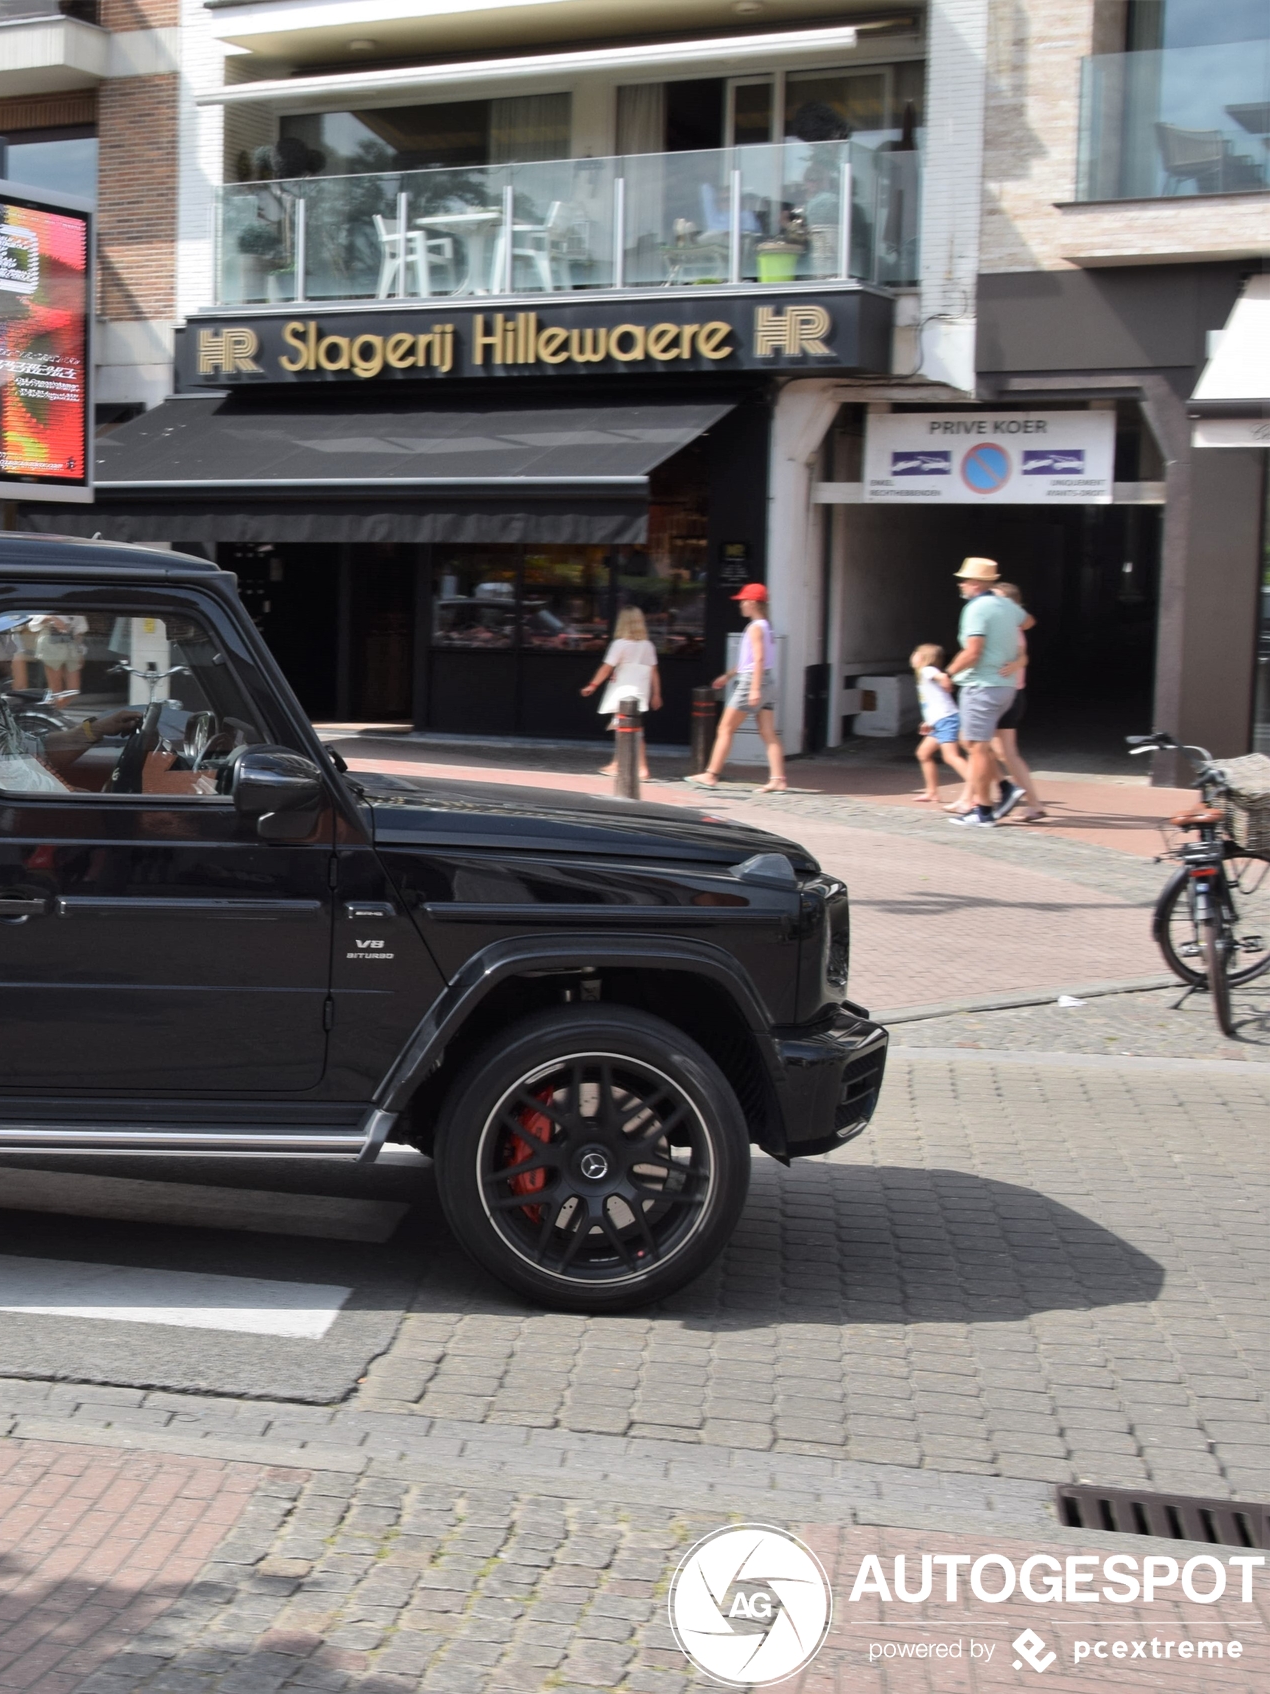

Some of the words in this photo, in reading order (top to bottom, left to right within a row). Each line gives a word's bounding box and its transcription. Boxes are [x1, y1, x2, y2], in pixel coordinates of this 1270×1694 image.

[197, 328, 261, 374] HR
[279, 320, 454, 378] Slagerij
[472, 311, 733, 367] Hillewaere
[754, 304, 833, 357] HR
[930, 420, 988, 435] PRIVE
[993, 419, 1049, 435] KOER
[356, 939, 385, 948] V8
